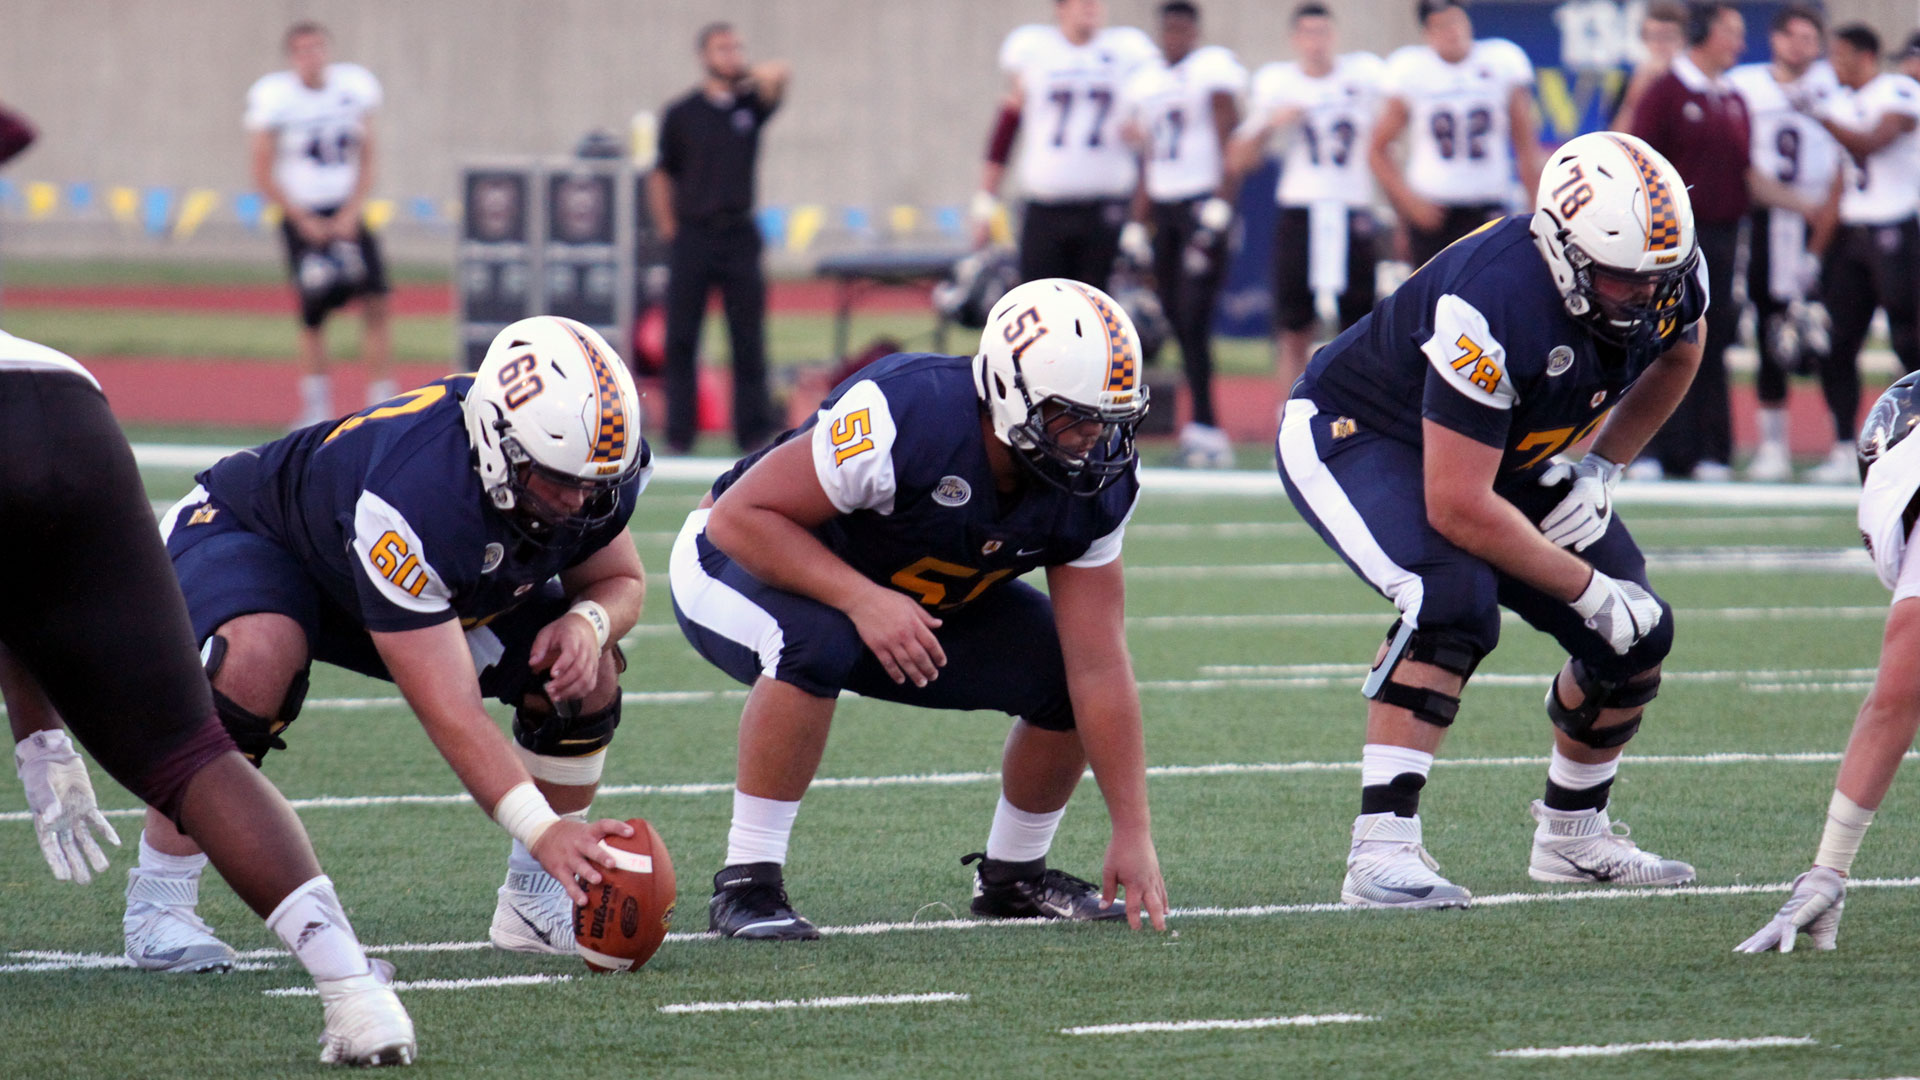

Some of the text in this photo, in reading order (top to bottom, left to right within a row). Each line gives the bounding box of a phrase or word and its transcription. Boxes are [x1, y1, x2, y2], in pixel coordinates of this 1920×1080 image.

[1048, 88, 1113, 148] 77
[1775, 126, 1801, 182] 9
[1550, 163, 1594, 222] 78
[1002, 305, 1050, 359] 51
[497, 352, 546, 412] 60
[1449, 333, 1503, 395] 78
[829, 407, 875, 468] 51
[368, 530, 429, 598] 60
[590, 883, 613, 940] Wilson
